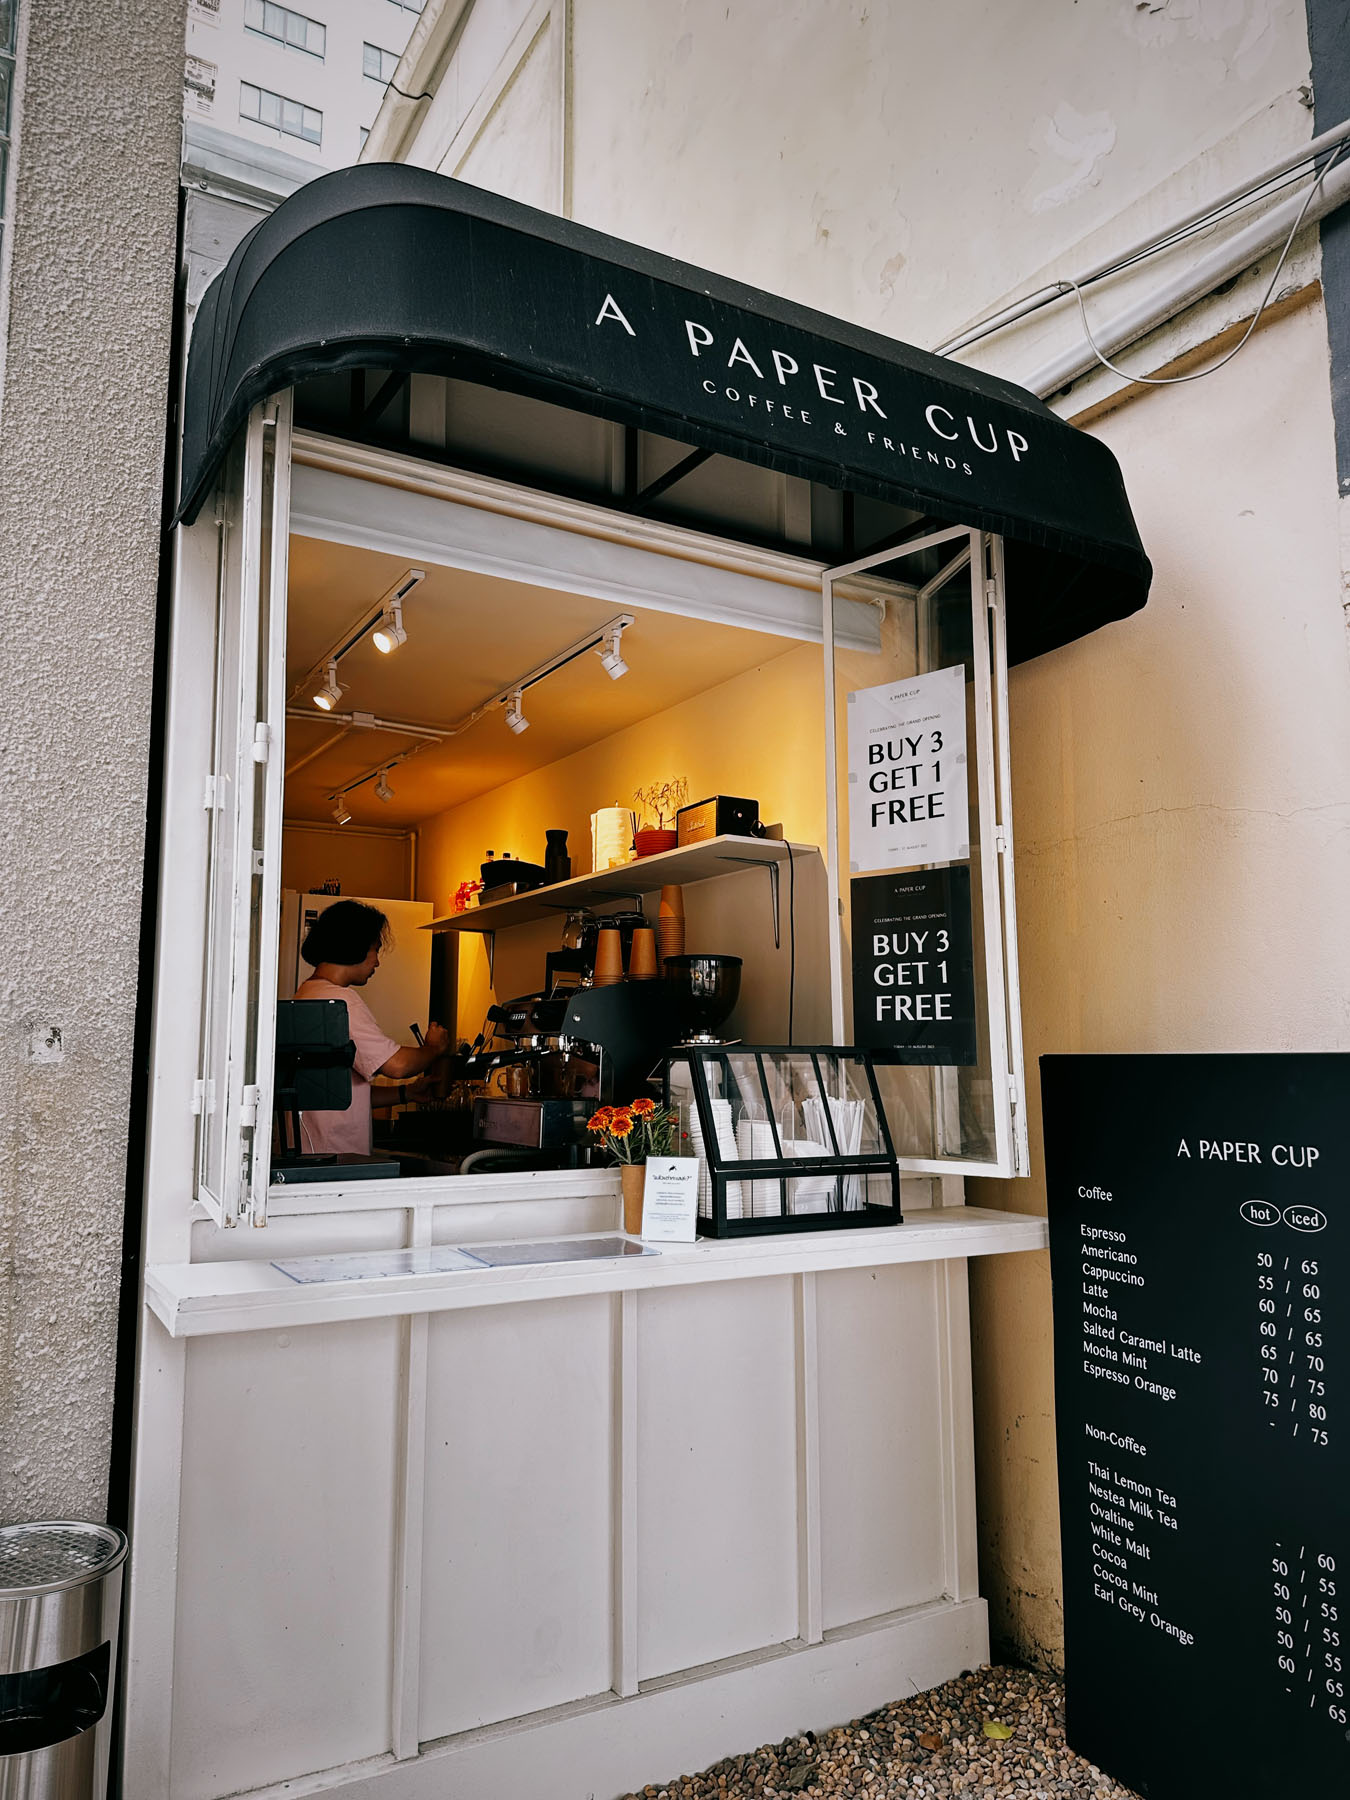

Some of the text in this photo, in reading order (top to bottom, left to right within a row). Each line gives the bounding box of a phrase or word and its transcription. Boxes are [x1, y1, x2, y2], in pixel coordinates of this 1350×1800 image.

[595, 293, 1029, 462] A PAPER CUP
[702, 379, 973, 476] COFFEE & FRIENDS
[868, 731, 943, 765] BUY 3
[869, 761, 940, 793] GET 1
[871, 792, 945, 827] FREE
[873, 930, 949, 956] BUY 3
[873, 961, 948, 986] GET 1
[876, 993, 952, 1021] FREE
[1177, 1139, 1319, 1167] A PAPER CUP
[1078, 1186, 1113, 1201] Coffee
[1250, 1205, 1318, 1227] hot iced
[1081, 1224, 1126, 1243] Espresso
[1081, 1244, 1137, 1265] Americano
[1257, 1253, 1318, 1276] 50 / 65
[1082, 1263, 1145, 1286] Cappuccino
[1258, 1276, 1319, 1299] 55 / 60
[1083, 1282, 1108, 1299] Latte
[1083, 1302, 1117, 1321] Mocha
[1259, 1299, 1321, 1323] 60 / 65
[1083, 1322, 1201, 1363] Salted Caramel Latte
[1260, 1322, 1322, 1347] 60 / 65
[1083, 1341, 1147, 1370] Mocha Mint
[1261, 1345, 1324, 1371] 65 / 70
[1083, 1361, 1176, 1401] Espresso Orange
[1262, 1368, 1325, 1396] 70 / 75
[1263, 1391, 1326, 1420] 75 / 80
[1085, 1423, 1146, 1456] Non-Coffee
[1294, 1423, 1298, 1436] /
[1311, 1428, 1328, 1445] 75
[1088, 1461, 1176, 1508] Thai Lemon Tea
[1089, 1482, 1177, 1530] Nestea Milk Tea
[1090, 1503, 1134, 1531] Ovaltine
[1091, 1522, 1150, 1560] White Malt
[1092, 1543, 1127, 1569] Cocoa
[1300, 1546, 1304, 1559] /
[1317, 1554, 1335, 1571] 60
[1093, 1564, 1159, 1606] Cocoa Mint
[1272, 1559, 1336, 1595] 50 / 55
[1094, 1584, 1194, 1645] Earl Grey Orange
[1273, 1583, 1338, 1621] 50 / 55
[1275, 1607, 1340, 1646] 50 / 55
[1277, 1631, 1342, 1671] 50 / 55
[1278, 1656, 1343, 1697] 60 / 65
[1310, 1694, 1315, 1708] /
[1328, 1705, 1346, 1723] 65
